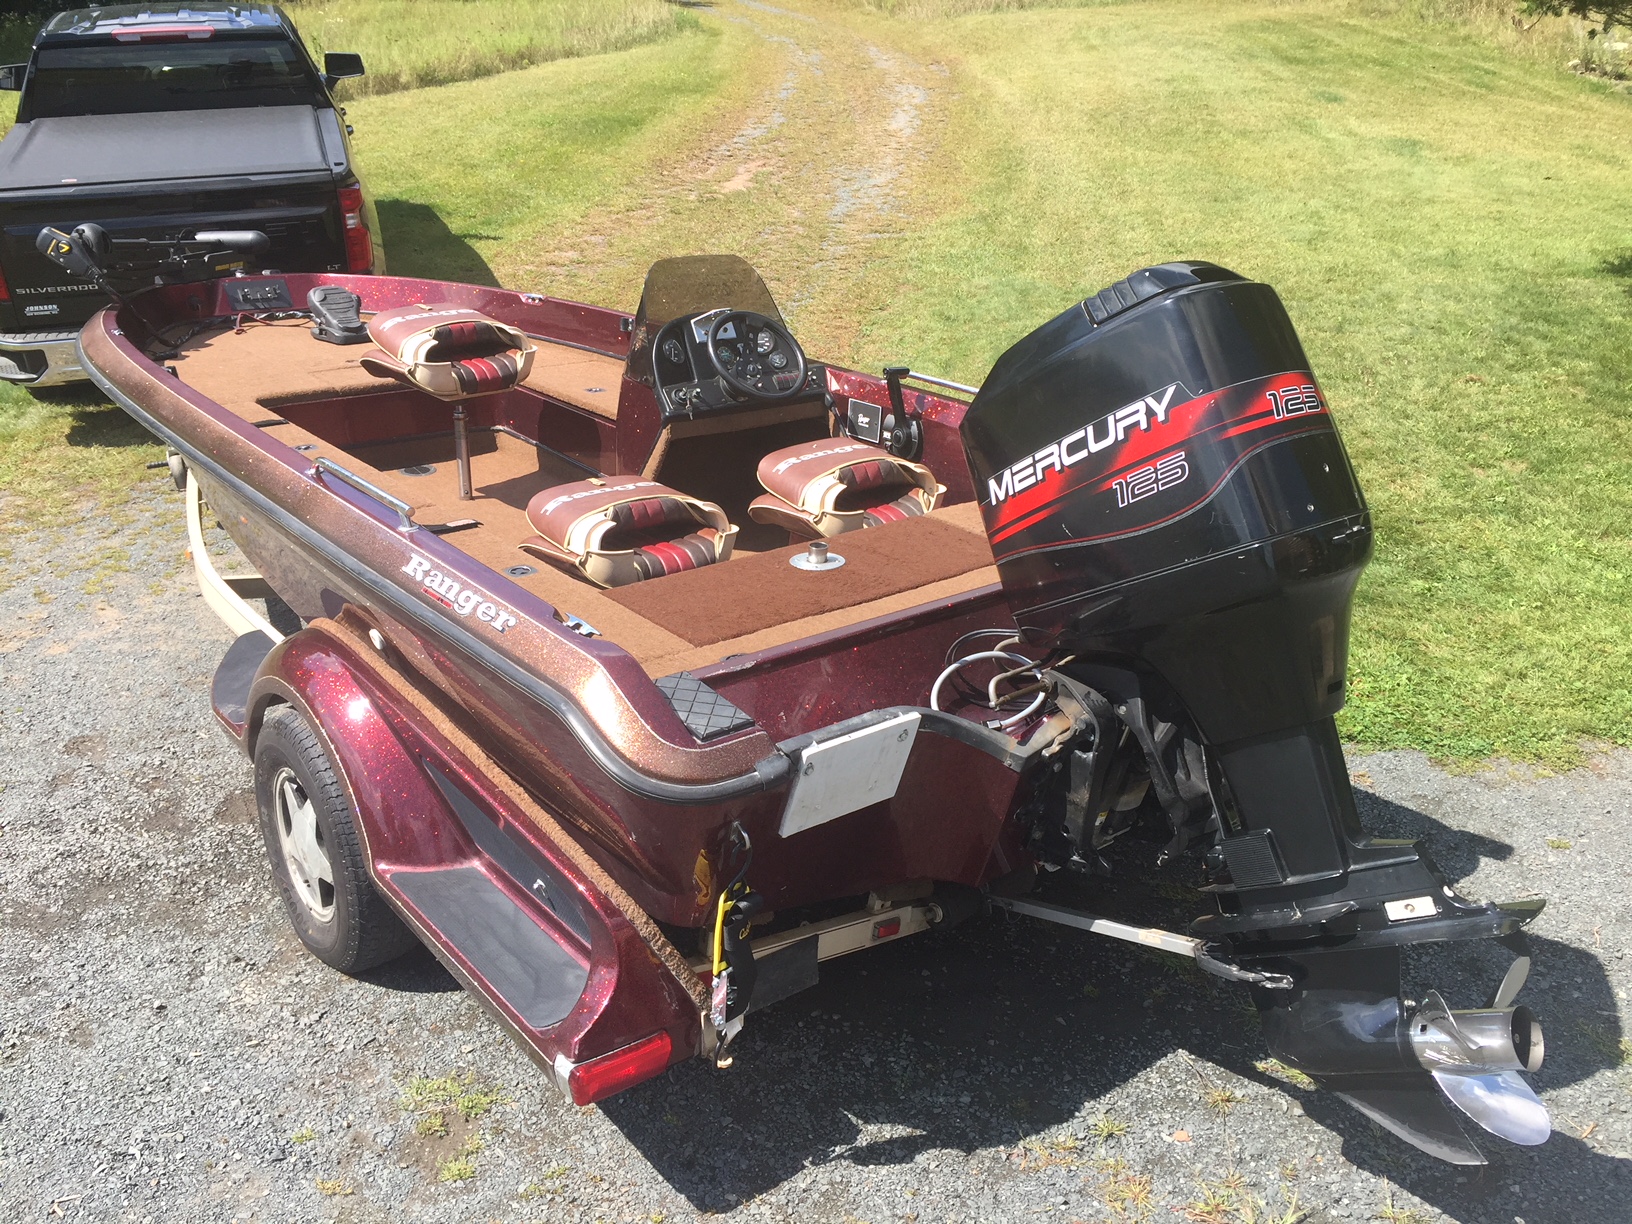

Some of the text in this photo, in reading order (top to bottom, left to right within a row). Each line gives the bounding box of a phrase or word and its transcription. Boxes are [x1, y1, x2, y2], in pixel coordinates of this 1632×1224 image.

[15, 284, 99, 295] SILVERADO
[25, 304, 58, 312] JOHNSON
[1265, 384, 1321, 420] 125
[771, 444, 875, 475] Range
[988, 384, 1177, 506] MERCURY
[1112, 451, 1189, 508] 125
[400, 552, 518, 634] Ranger
